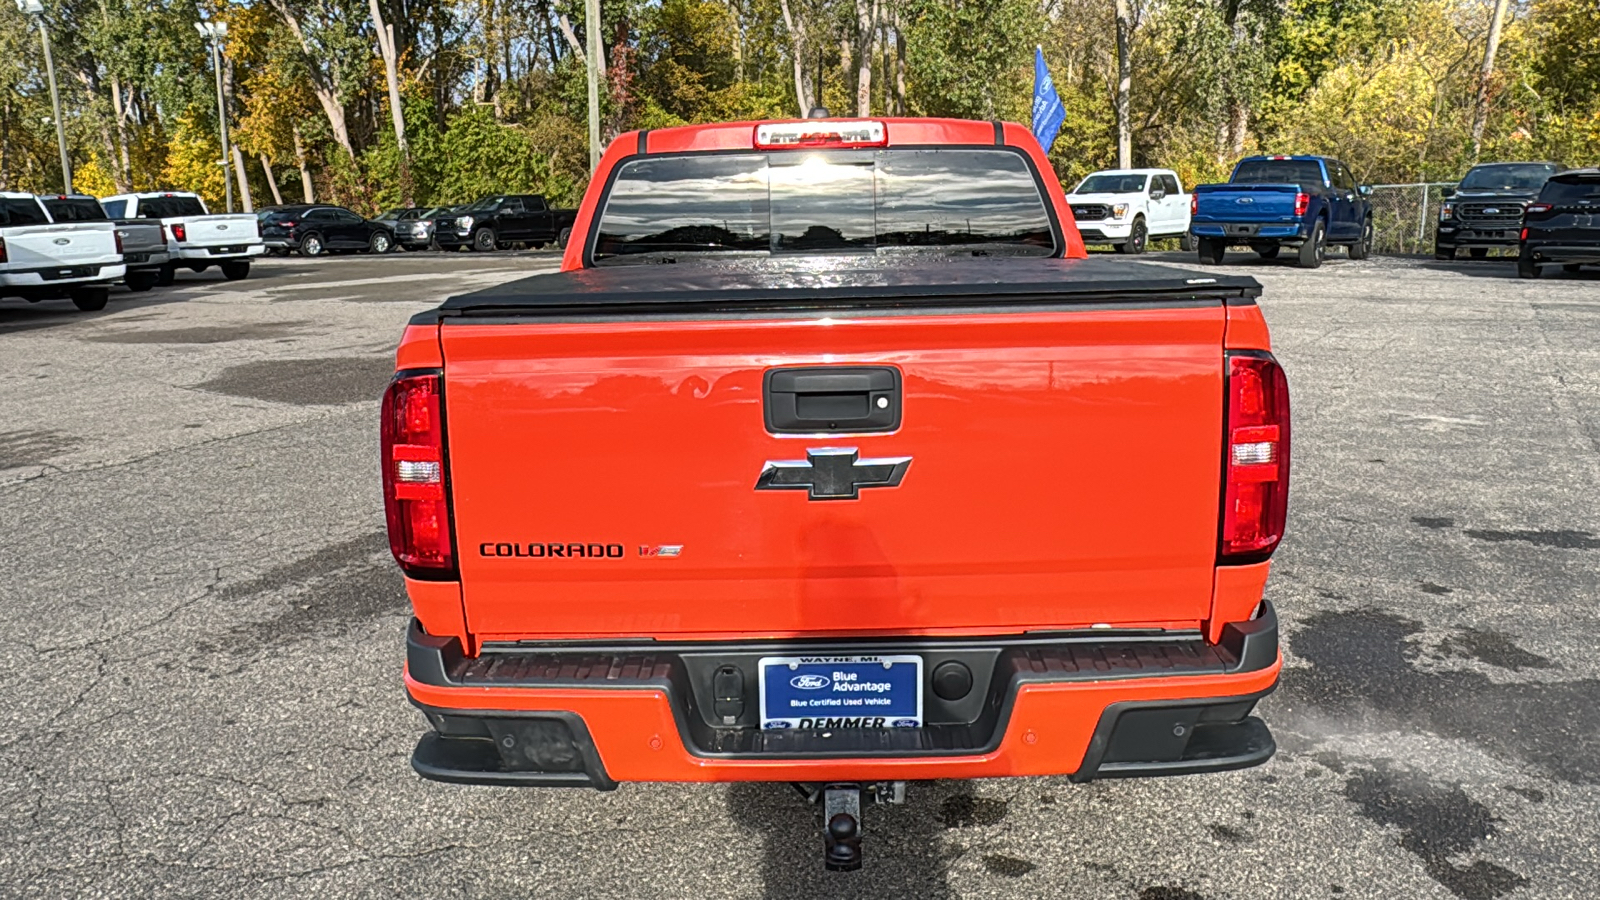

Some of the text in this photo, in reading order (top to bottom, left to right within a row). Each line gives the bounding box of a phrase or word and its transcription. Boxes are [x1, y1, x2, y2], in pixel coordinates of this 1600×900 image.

[479, 542, 624, 558] COLORADO
[796, 675, 825, 688] Ford
[833, 671, 857, 681] Blue
[833, 682, 891, 693] Advantage
[809, 698, 842, 706] Certified
[798, 717, 886, 729] DEMMER
